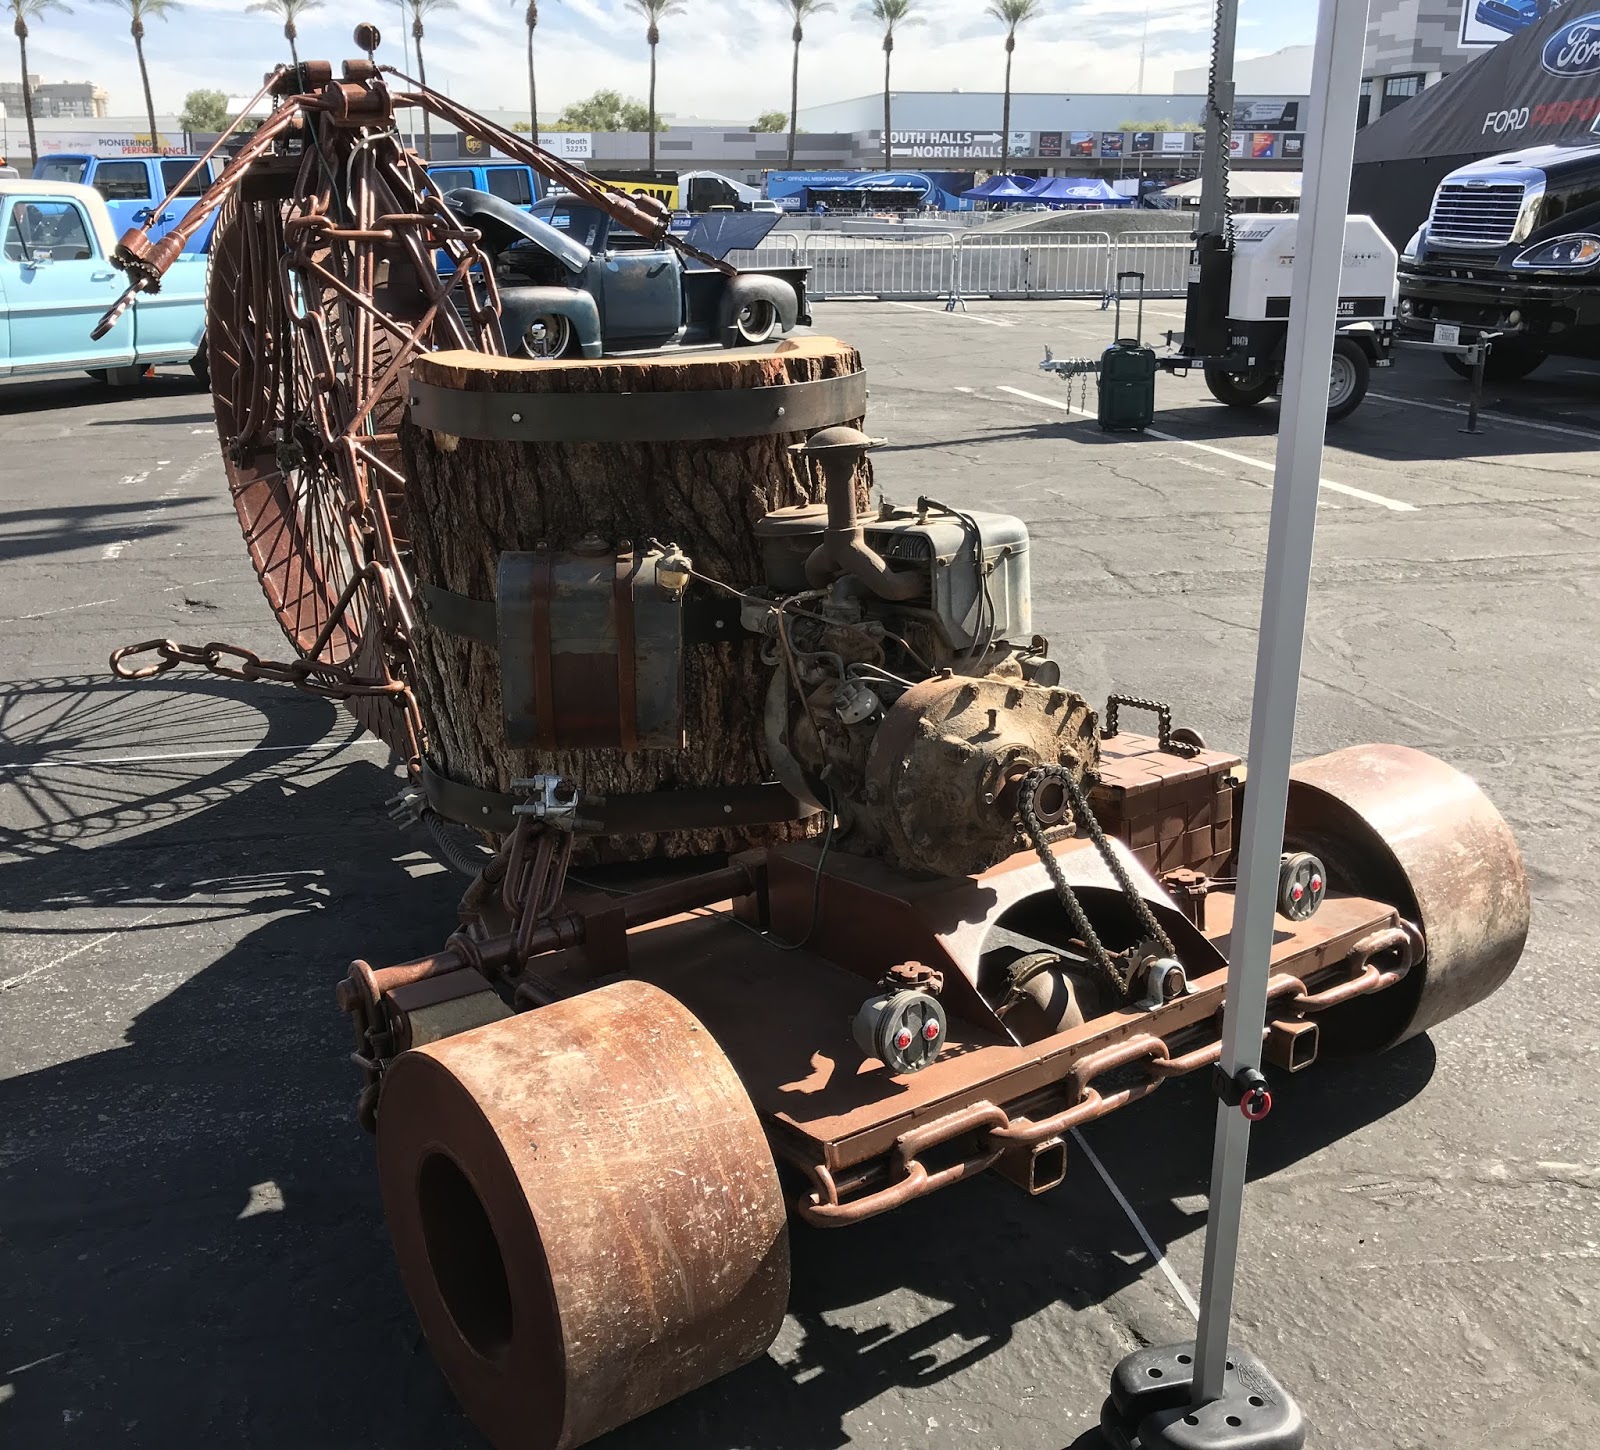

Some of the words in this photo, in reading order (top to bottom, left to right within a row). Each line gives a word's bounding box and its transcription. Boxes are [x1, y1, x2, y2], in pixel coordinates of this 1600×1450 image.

[1557, 23, 1600, 67] For
[1481, 107, 1530, 135] FORD
[1529, 96, 1600, 129] PERFO
[98, 138, 153, 147] PIONEERING
[565, 137, 588, 145] Booth
[880, 131, 926, 144] SOUTH
[930, 132, 972, 144] HALLS
[913, 146, 959, 158] NORTH
[963, 146, 1003, 158] HALLS
